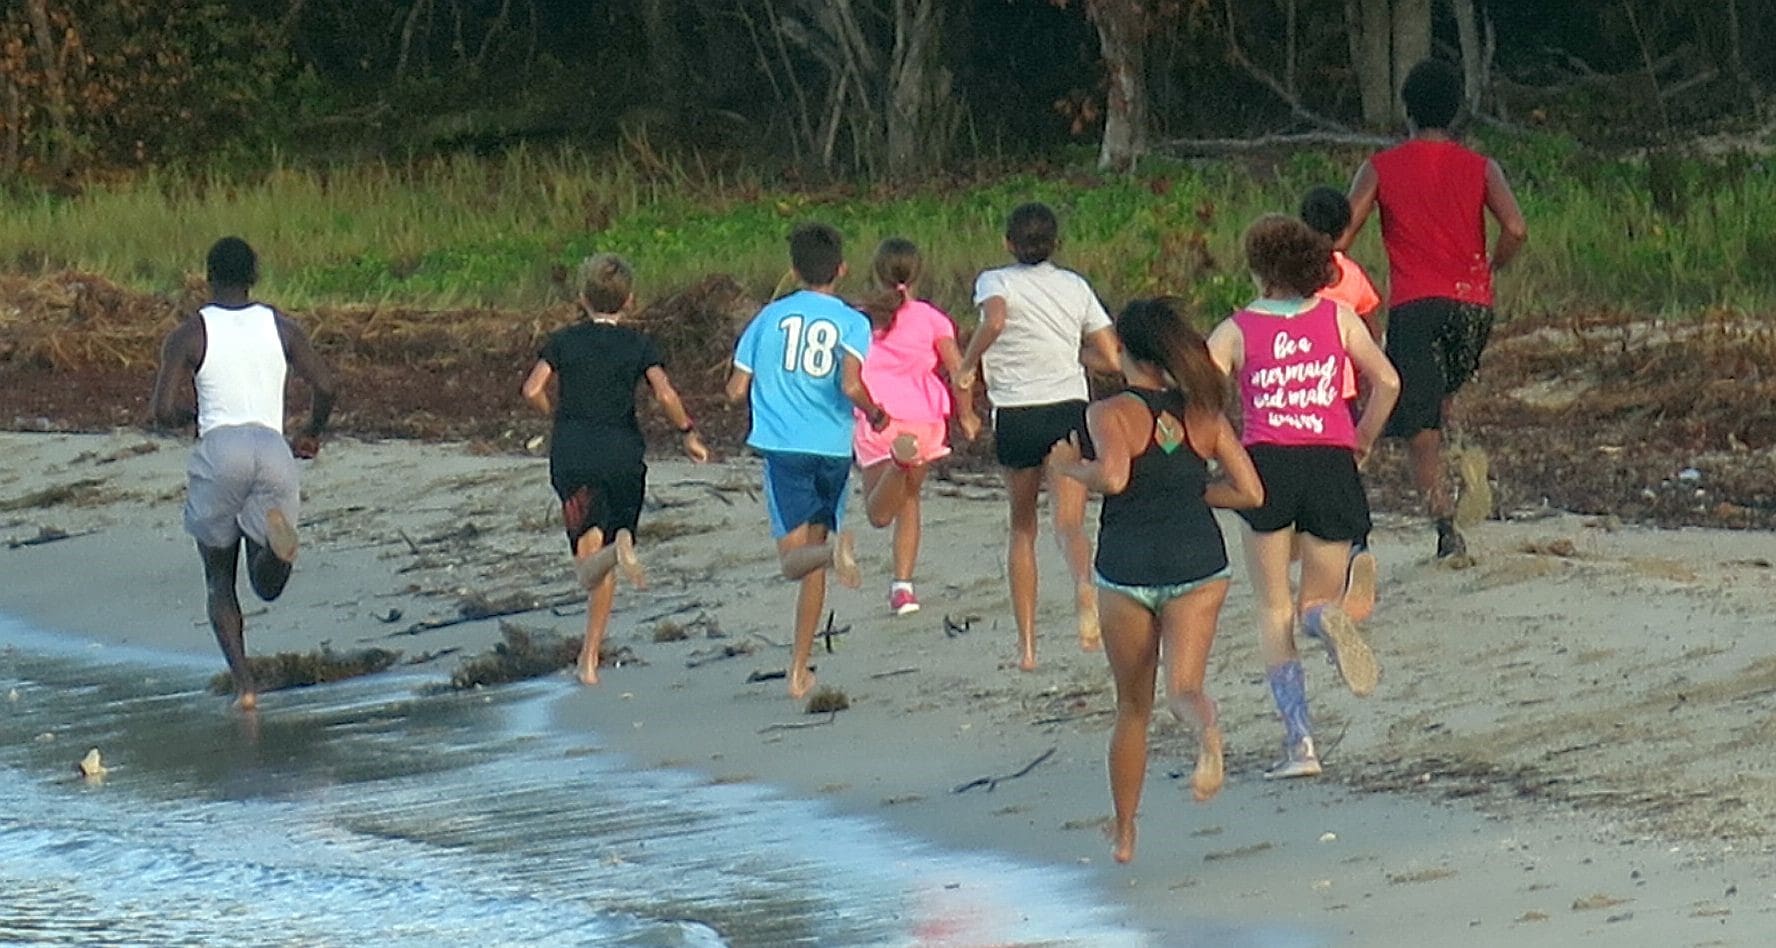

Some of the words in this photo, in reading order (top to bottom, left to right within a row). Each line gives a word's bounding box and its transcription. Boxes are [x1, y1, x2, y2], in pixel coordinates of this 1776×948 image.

[779, 314, 839, 378] 18
[1298, 337, 1313, 353] a
[1250, 355, 1338, 388] mermaid
[1288, 377, 1338, 408] make
